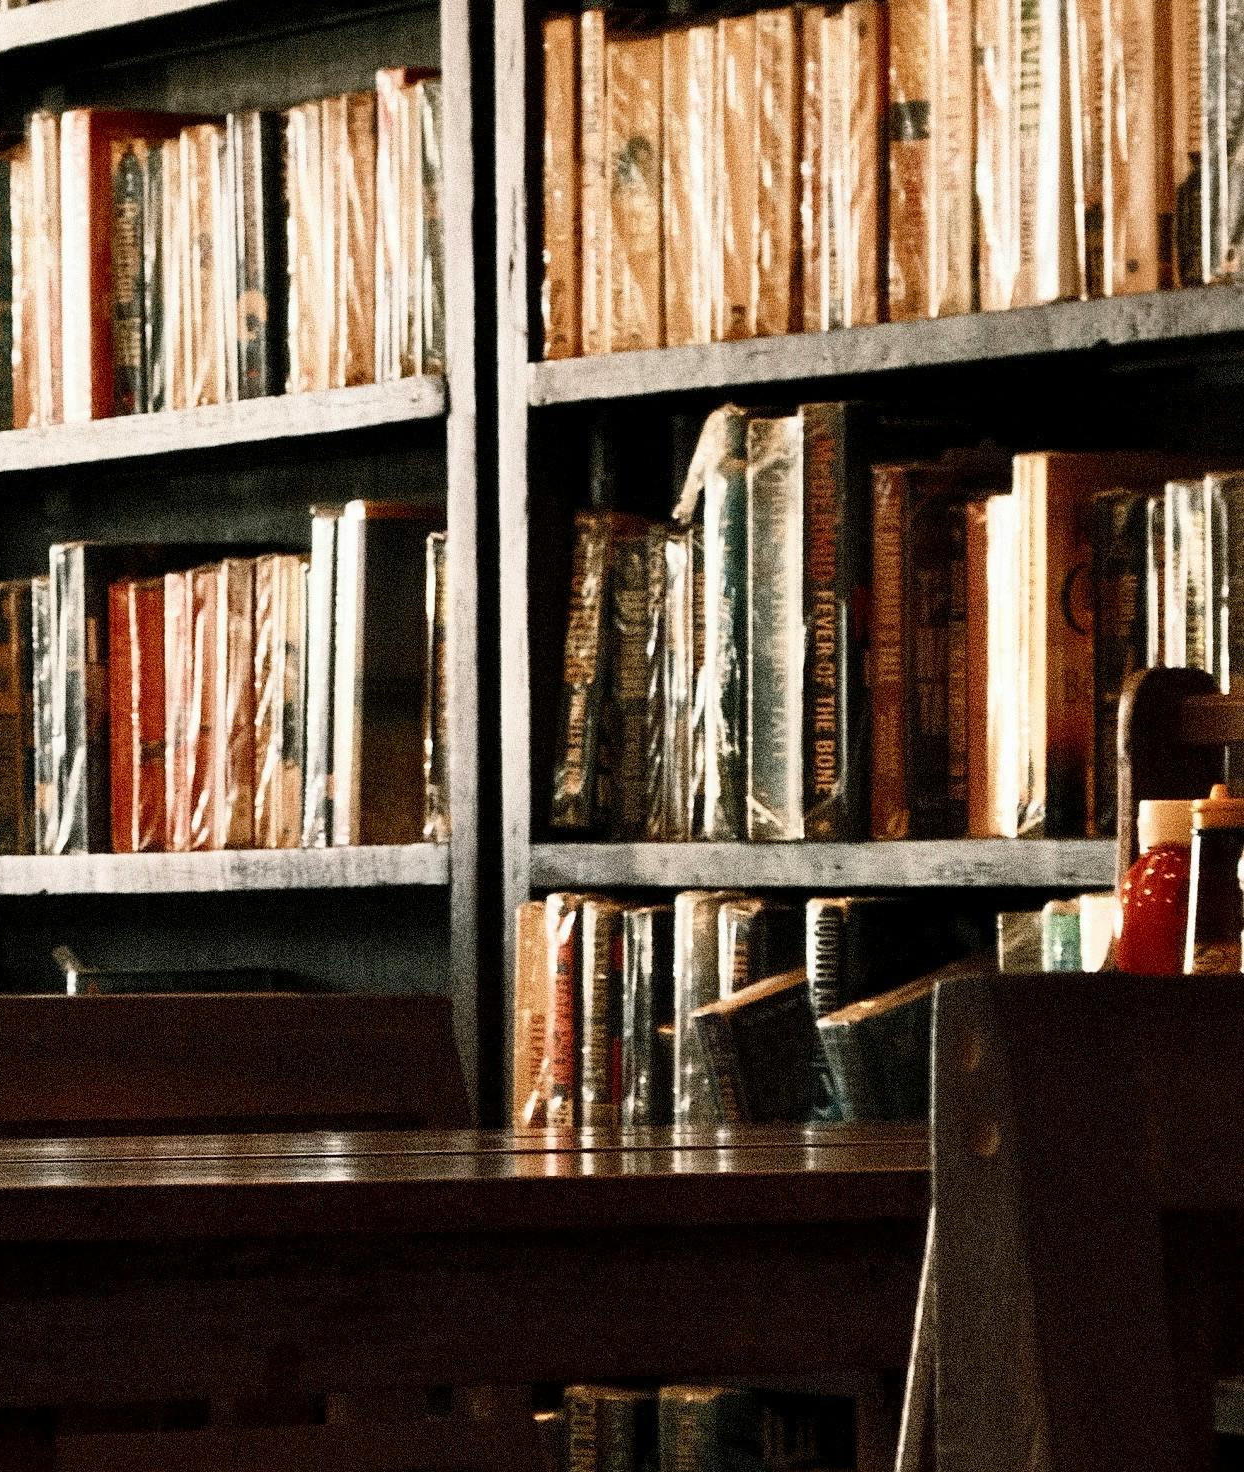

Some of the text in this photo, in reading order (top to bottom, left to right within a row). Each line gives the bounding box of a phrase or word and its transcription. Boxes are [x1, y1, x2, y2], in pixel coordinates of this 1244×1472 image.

[815, 589, 836, 795] FEVER OF THE BONE
[873, 647, 901, 684] TALE
[816, 917, 839, 978] JUDITH
